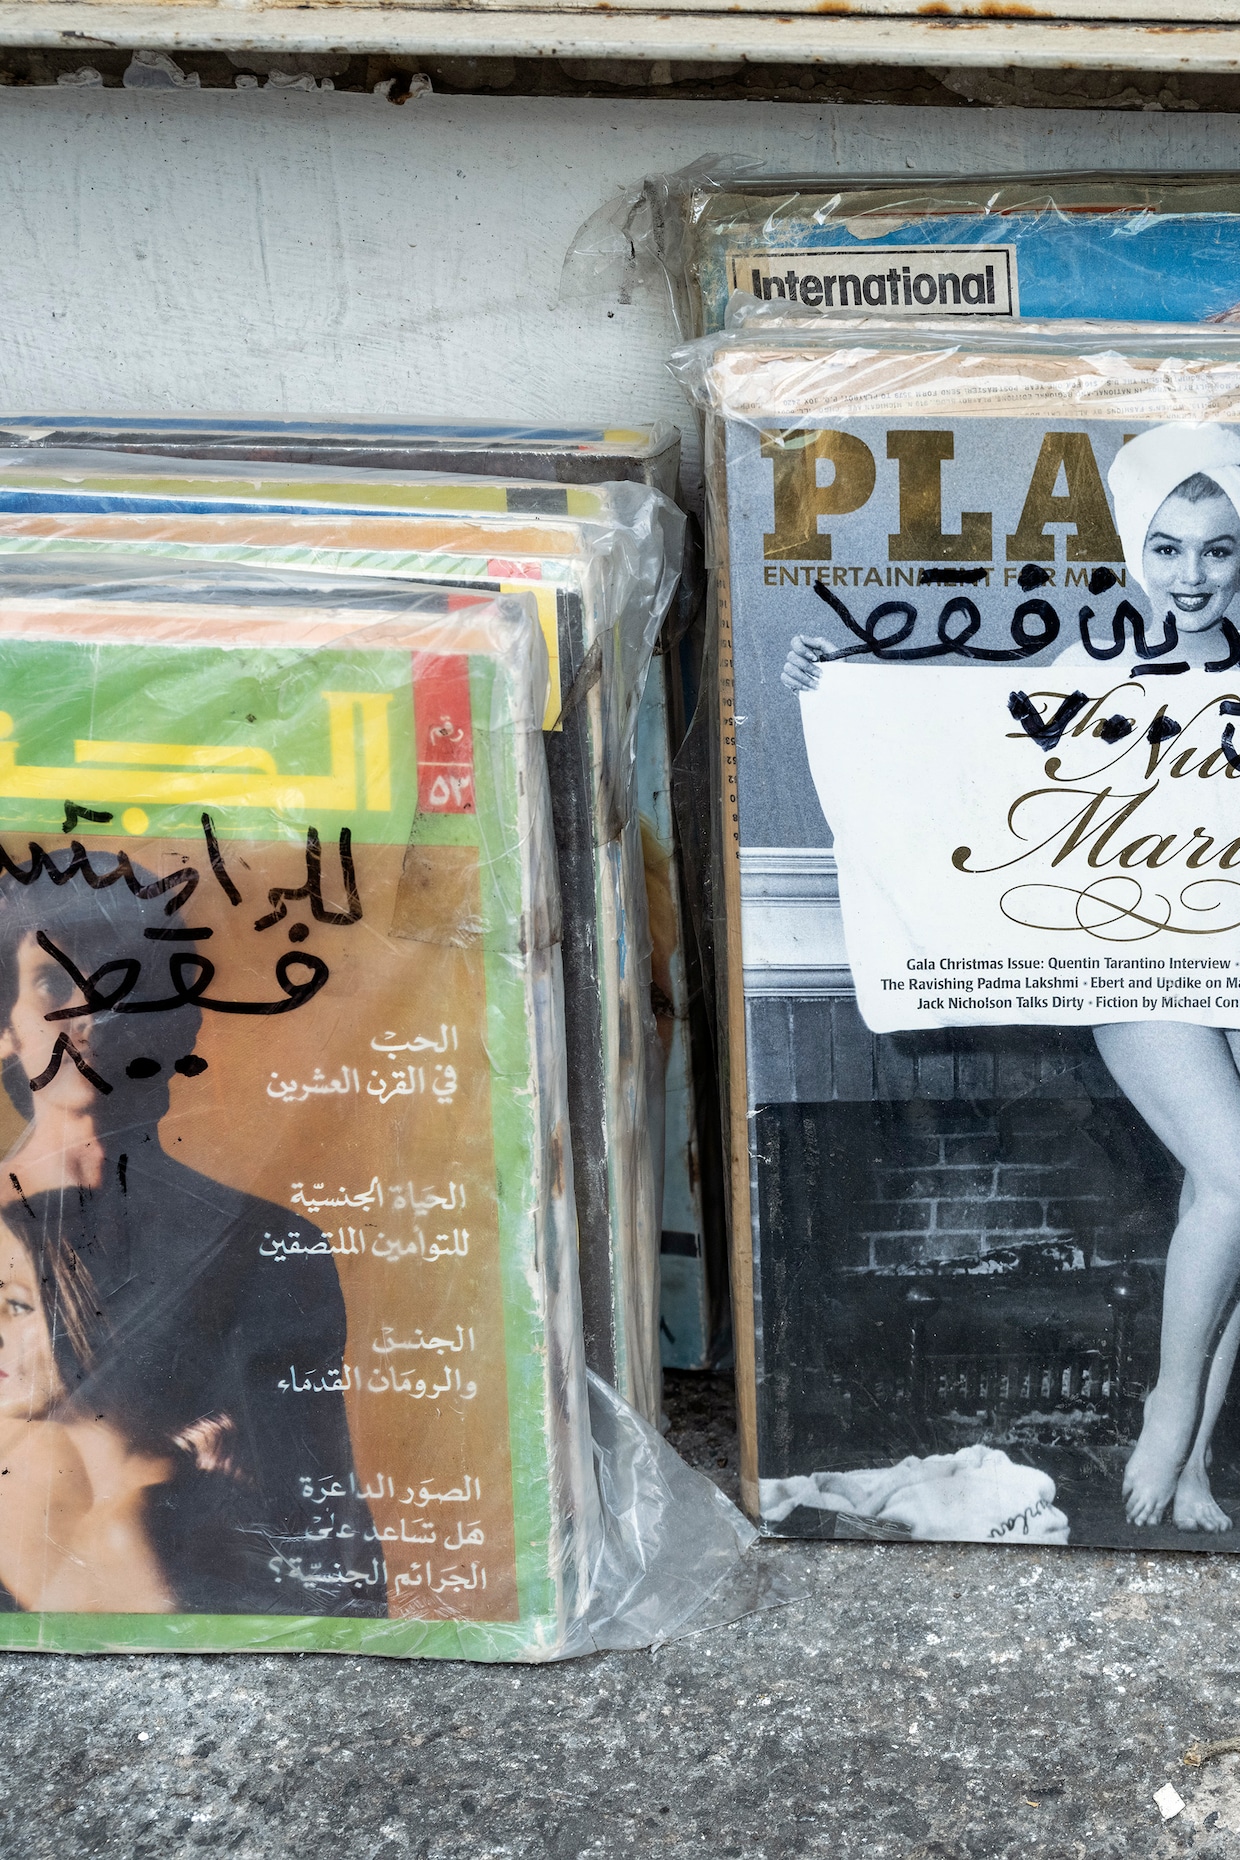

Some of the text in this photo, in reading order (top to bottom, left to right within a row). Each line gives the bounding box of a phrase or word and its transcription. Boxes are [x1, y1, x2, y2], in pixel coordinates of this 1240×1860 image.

[752, 265, 996, 307] International
[1004, 566, 1056, 588] FR
[1065, 566, 1125, 588] MN
[811, 564, 1062, 664] فقط
[36, 922, 330, 1018] فقط
[907, 958, 936, 970] Gala
[939, 957, 1004, 970] Christmas
[1007, 957, 1044, 970] Issue:
[1048, 957, 1100, 971] Quentin
[1104, 957, 1165, 969] Tarantino
[1169, 957, 1231, 969] Interview
[881, 978, 905, 991] The
[908, 977, 974, 993] Ravishing
[977, 977, 1021, 990] Padma
[1025, 976, 1079, 989] Lakshmi
[1090, 976, 1125, 989] Ebert
[1128, 977, 1152, 989] and
[1156, 977, 1201, 992] Updike
[1205, 979, 1222, 990] on
[917, 997, 945, 1010] Jack
[948, 996, 1012, 1010] Nicholson
[1016, 996, 1048, 1009] Talks
[1052, 996, 1084, 1011] Dirty
[1095, 996, 1139, 1008] Fiction
[1142, 996, 1157, 1011] by
[1161, 996, 1211, 1009] Michael
[266, 1064, 458, 1104] في القرن العشرين
[259, 1226, 365, 1262] الملتصقين
